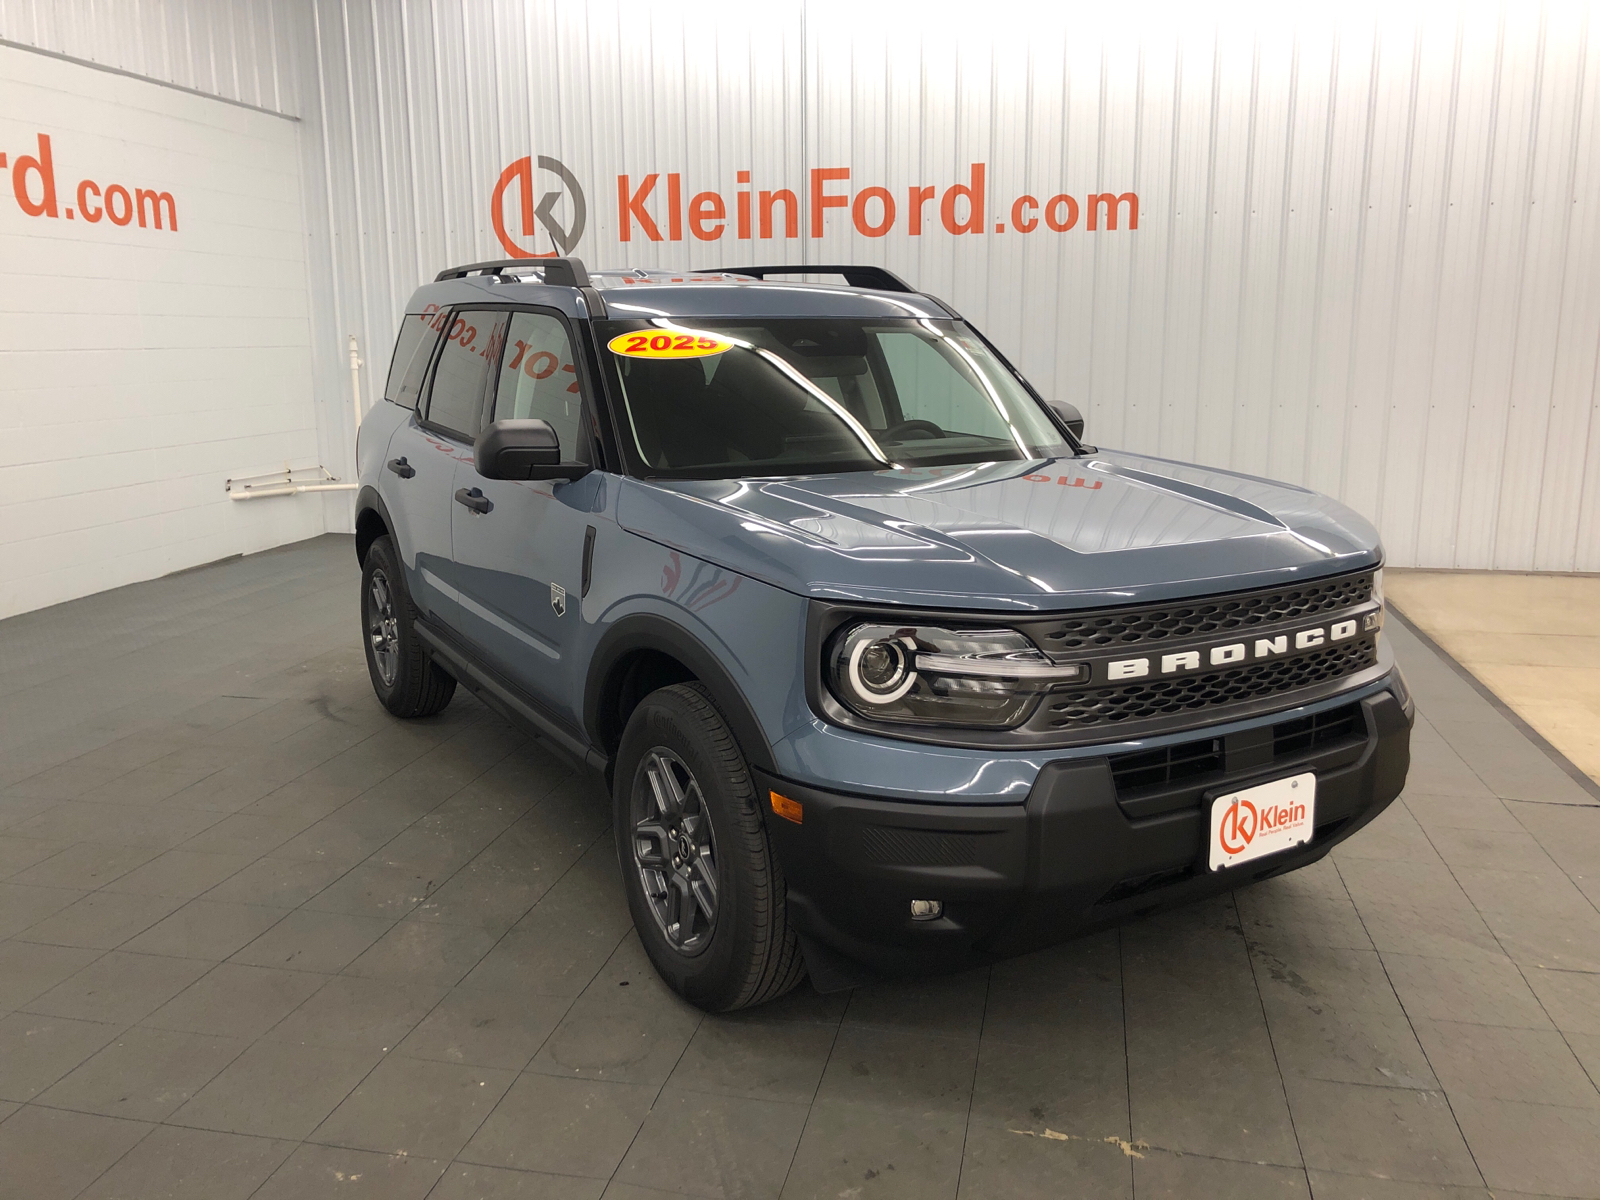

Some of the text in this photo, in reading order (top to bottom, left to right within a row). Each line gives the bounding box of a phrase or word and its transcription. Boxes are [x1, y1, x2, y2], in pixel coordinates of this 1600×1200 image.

[0, 133, 178, 232] d.com
[618, 163, 1138, 242] KleinFord.com
[625, 335, 719, 353] 2025
[1107, 619, 1357, 681] BRONCO
[1259, 800, 1306, 832] Klein
